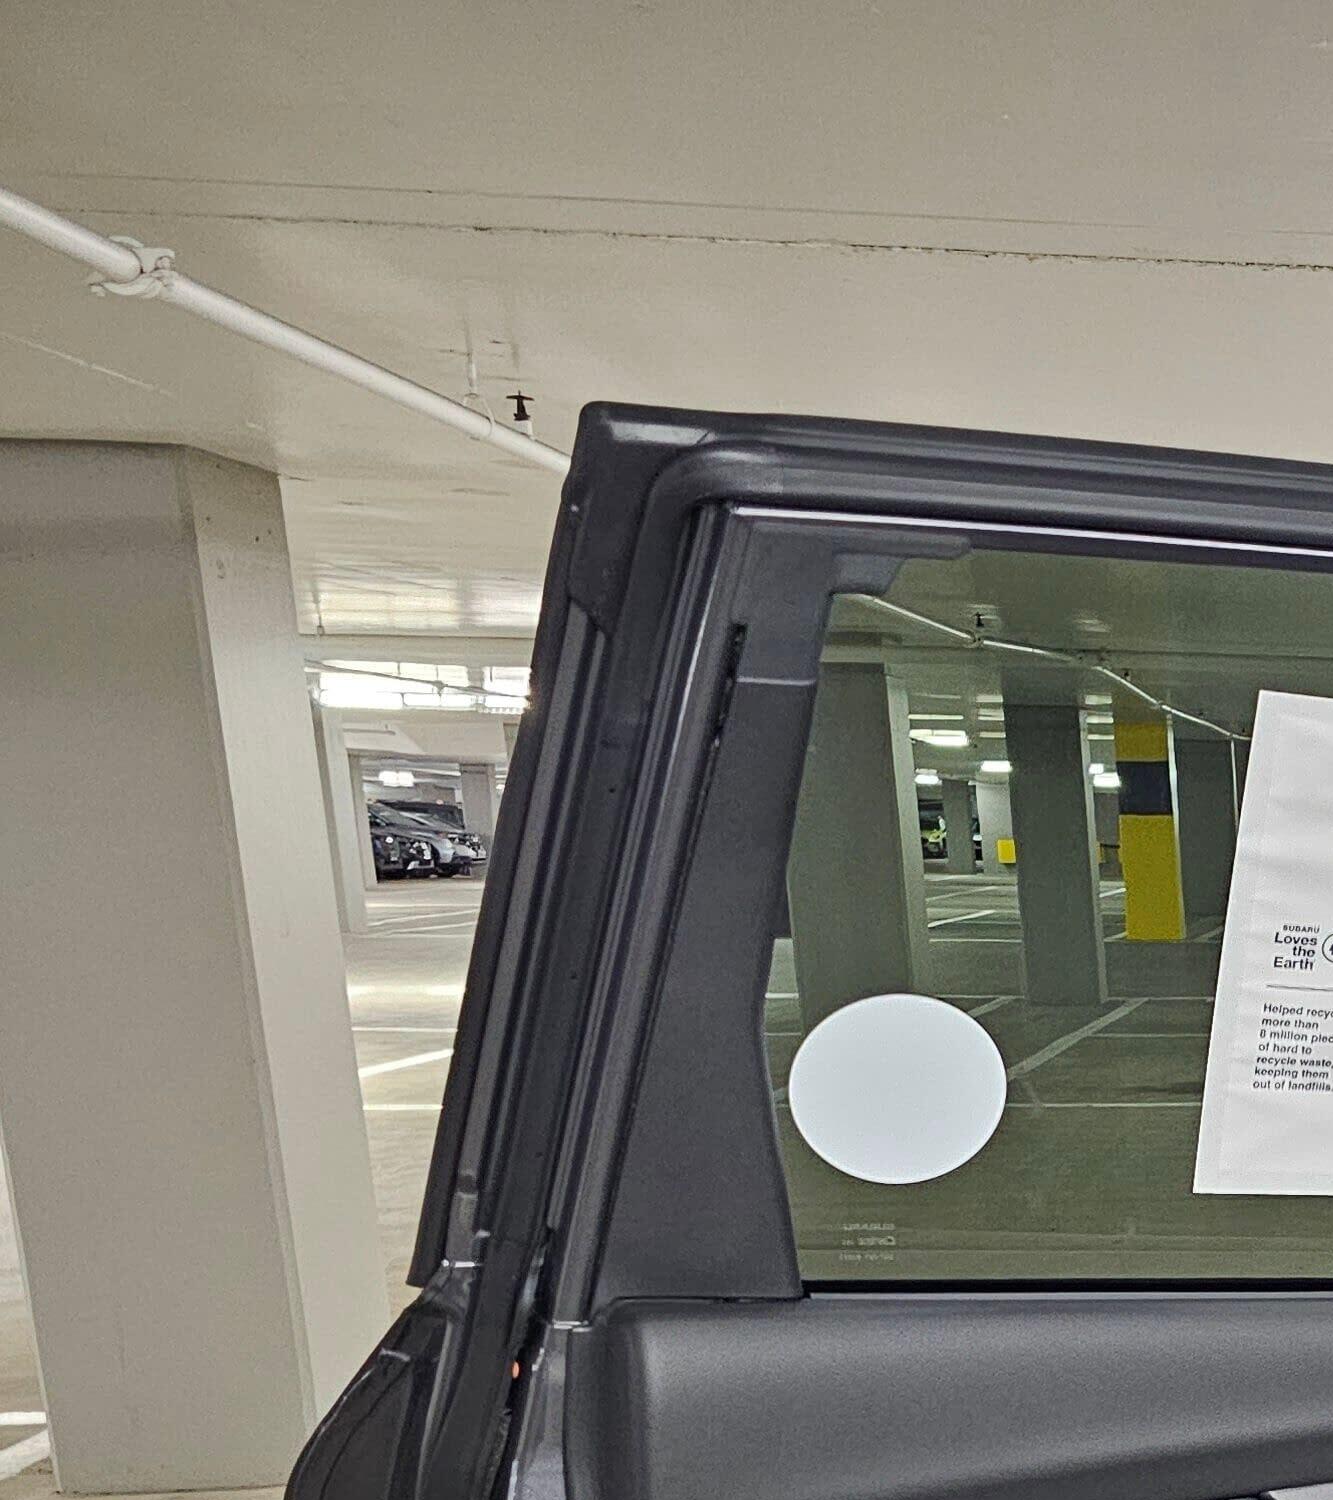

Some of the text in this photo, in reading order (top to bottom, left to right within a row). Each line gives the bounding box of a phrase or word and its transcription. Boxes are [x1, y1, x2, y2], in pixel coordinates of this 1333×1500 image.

[1274, 932, 1317, 946] Loves
[1293, 946, 1315, 957] the
[1274, 956, 1315, 971] Earth
[1264, 1003, 1303, 1016] Helped
[1262, 1018, 1318, 1030] more than
[1270, 1030, 1307, 1041] million
[1259, 1042, 1312, 1055] of hard to
[1257, 1057, 1296, 1066] recycle
[1255, 1066, 1328, 1079] keeping them
[1253, 1080, 1270, 1089] out
[1275, 1080, 1285, 1090] of
